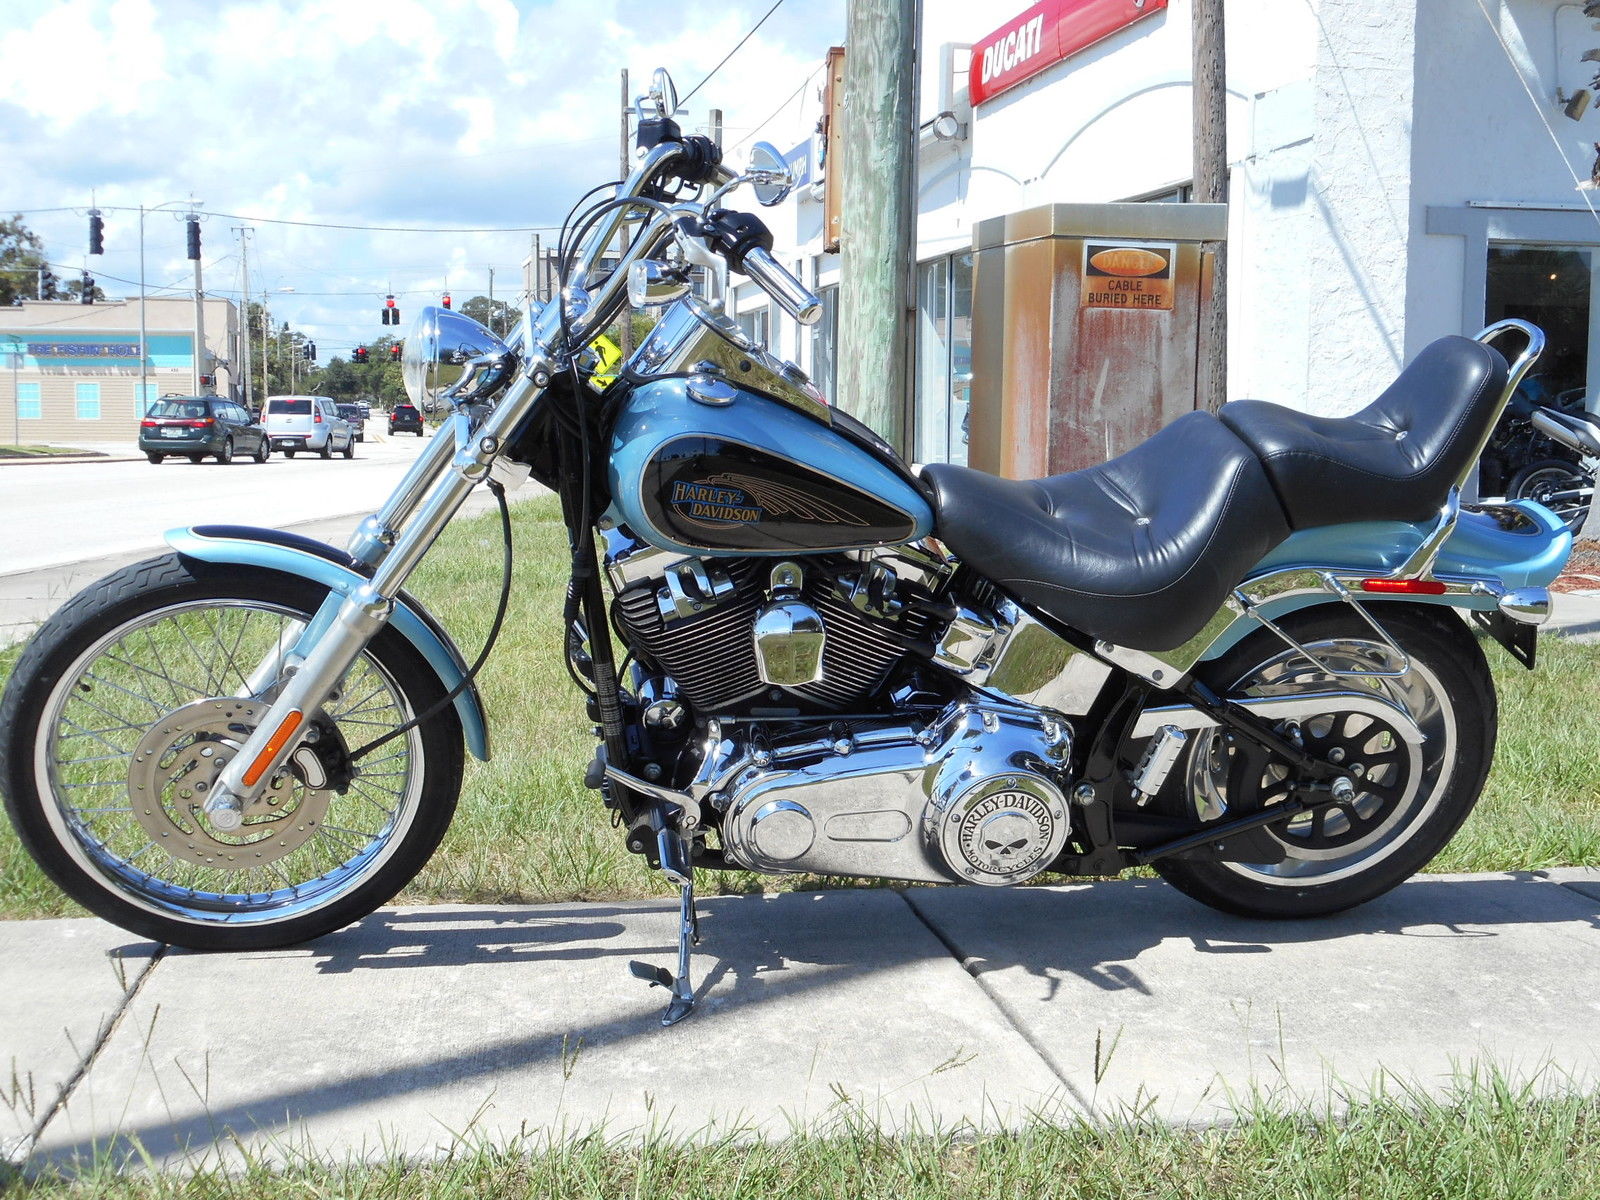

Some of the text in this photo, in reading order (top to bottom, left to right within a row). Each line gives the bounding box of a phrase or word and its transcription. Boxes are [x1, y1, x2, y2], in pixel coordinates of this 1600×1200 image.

[981, 13, 1044, 85] DUCATI
[1108, 279, 1143, 291] CABLE
[1088, 292, 1162, 305] BURIED HERE
[692, 503, 760, 522] DAVIDSON
[966, 845, 1043, 873] MOTORCYCLES
